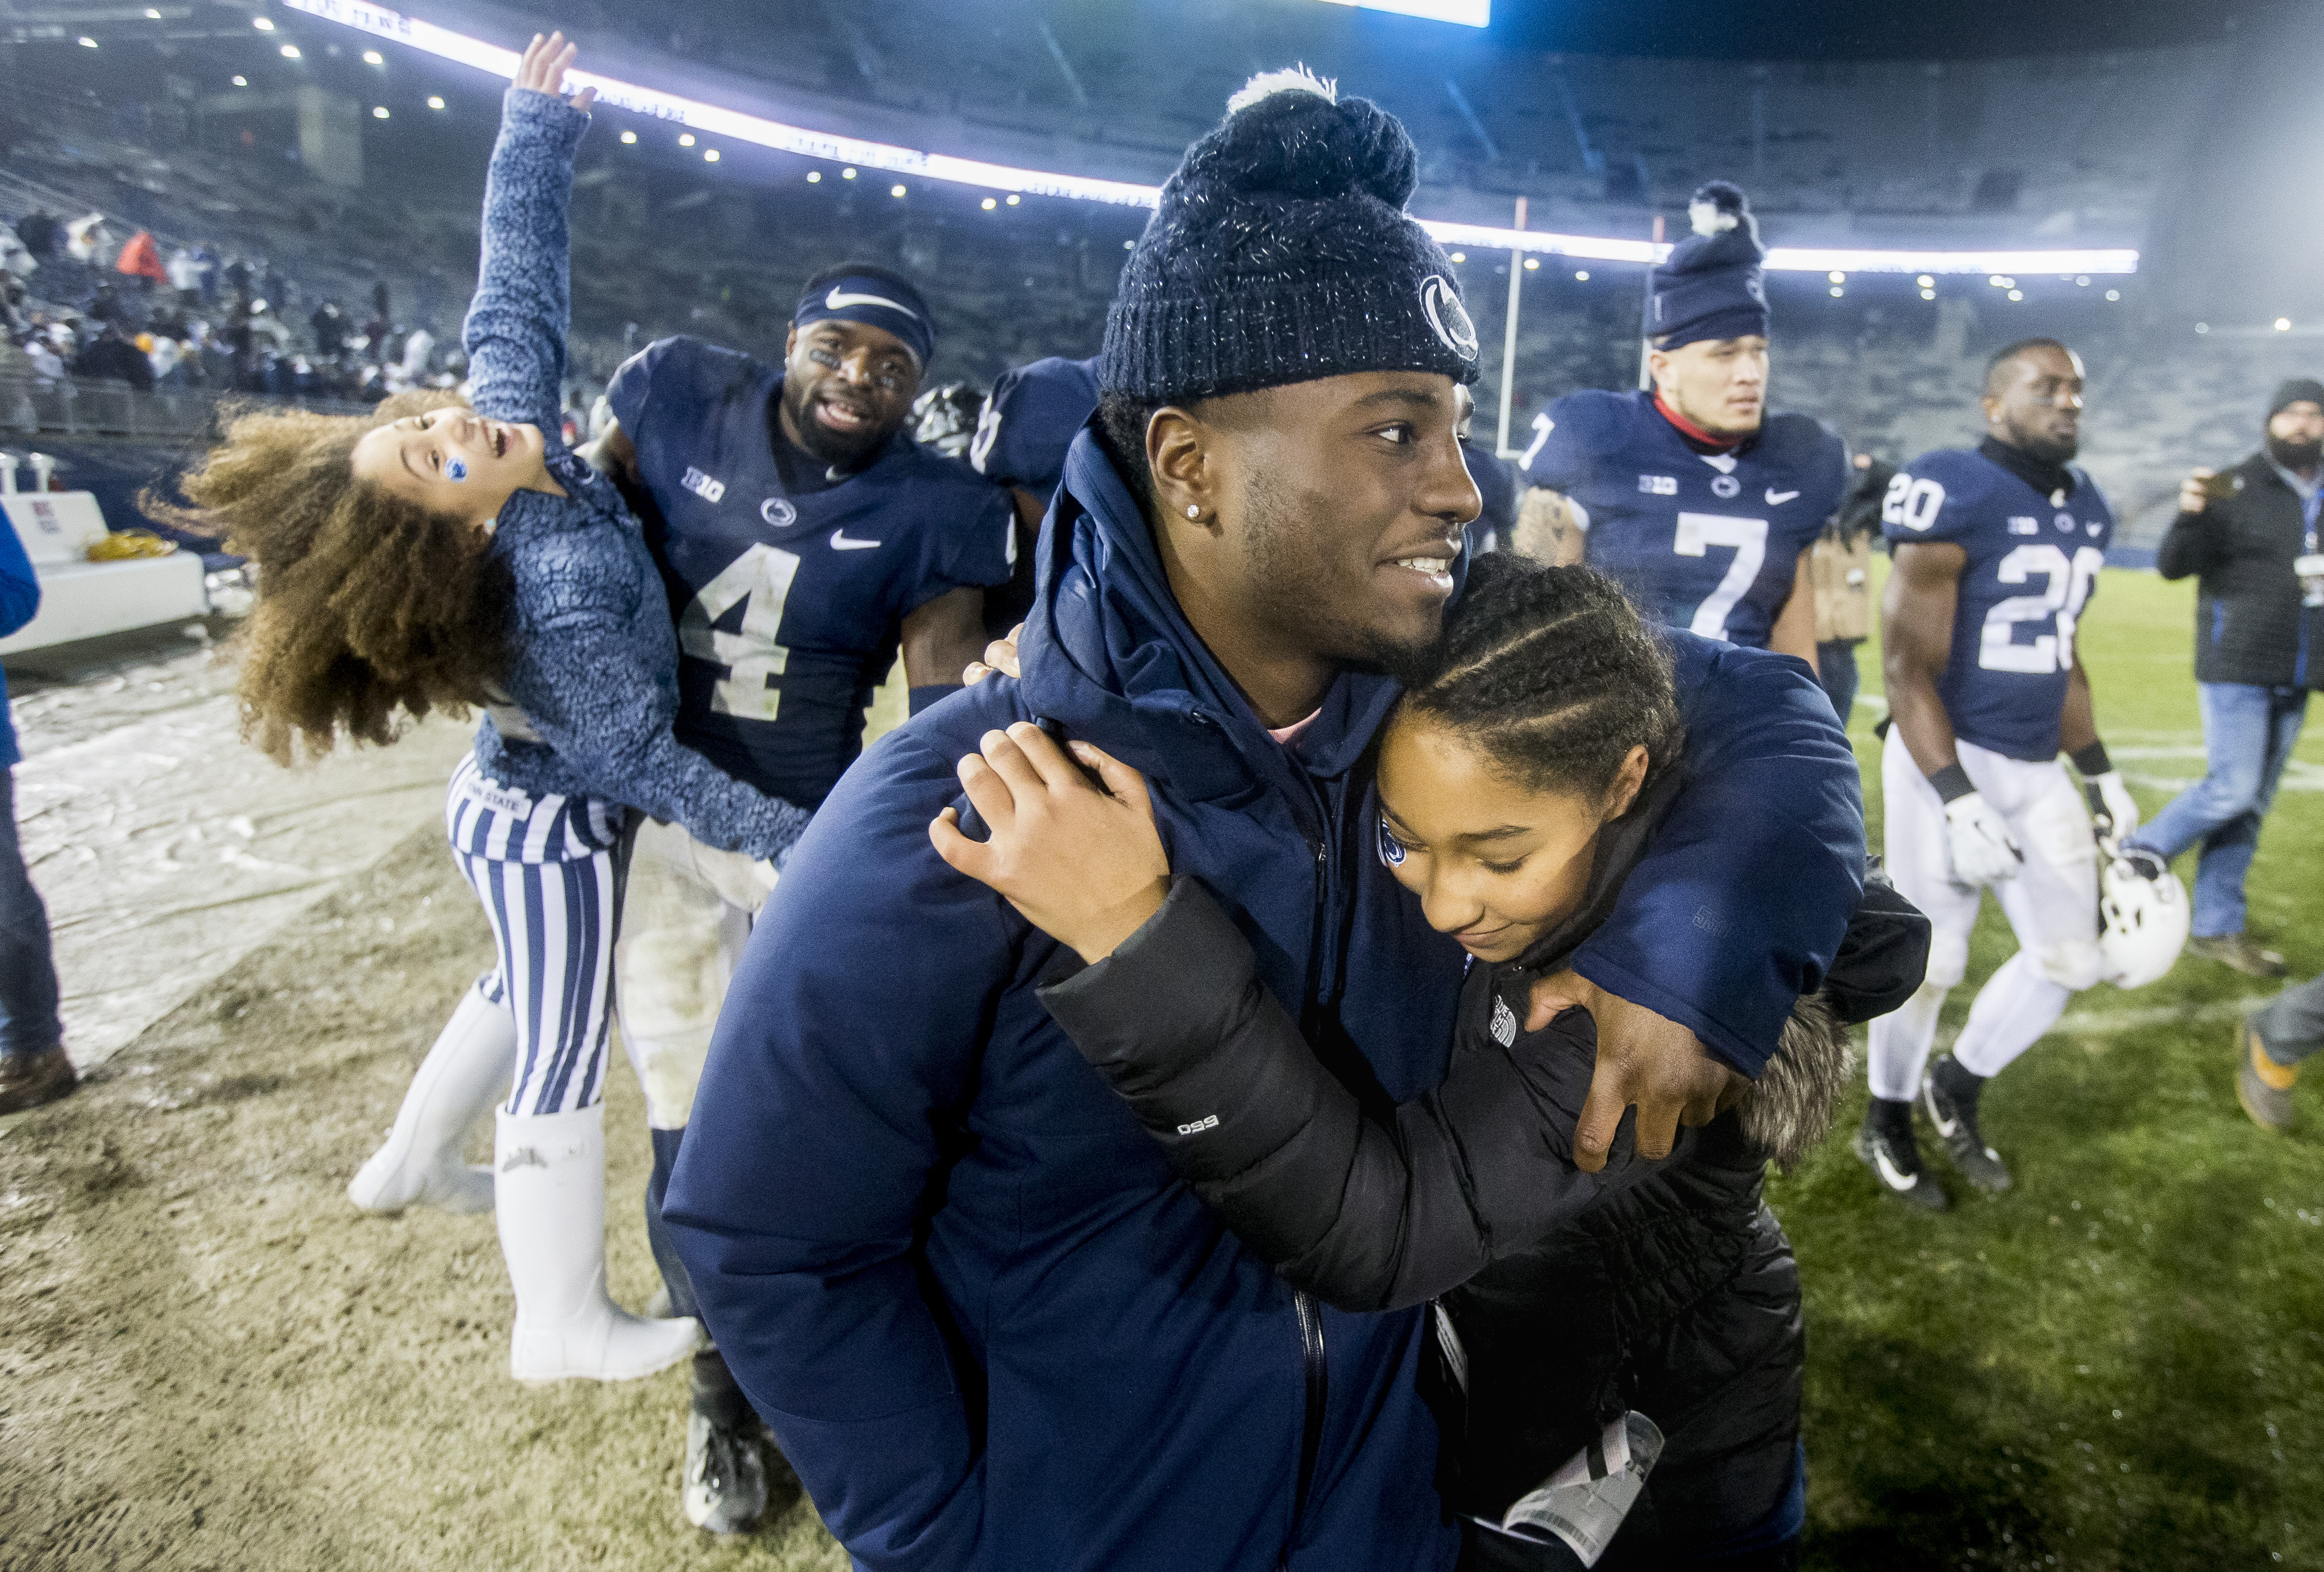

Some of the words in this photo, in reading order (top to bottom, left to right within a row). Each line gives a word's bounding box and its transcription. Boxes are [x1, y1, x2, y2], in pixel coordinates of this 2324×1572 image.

[1518, 412, 1554, 471] 7
[1882, 473, 1945, 531] 20
[1674, 511, 1769, 641] 7
[679, 542, 800, 721] 4
